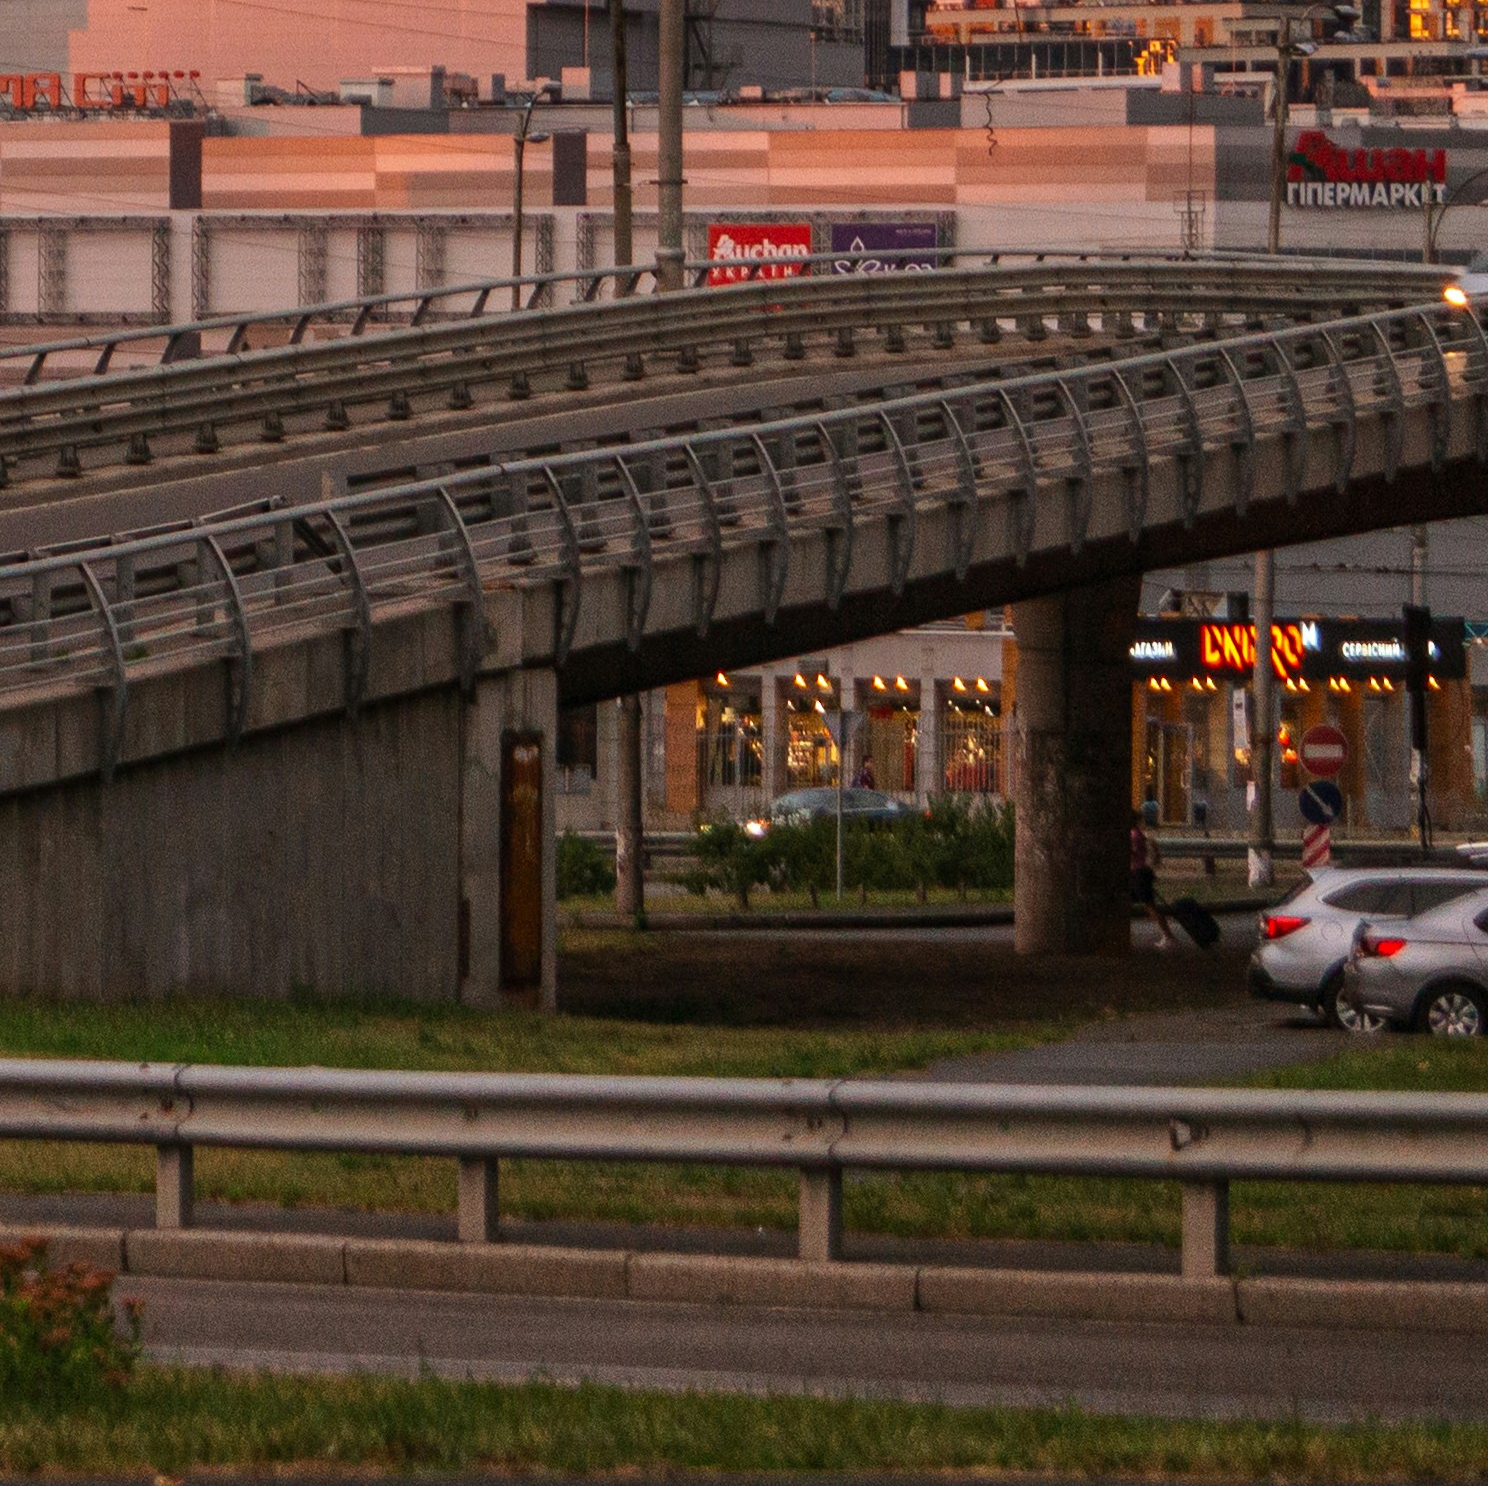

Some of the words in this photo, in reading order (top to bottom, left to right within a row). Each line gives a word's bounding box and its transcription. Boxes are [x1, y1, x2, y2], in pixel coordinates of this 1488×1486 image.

[1286, 130, 1448, 183] Ашан
[713, 234, 809, 260] Auchan
[711, 264, 794, 278] УКРАЇН
[1201, 624, 1304, 680] DNIRO
